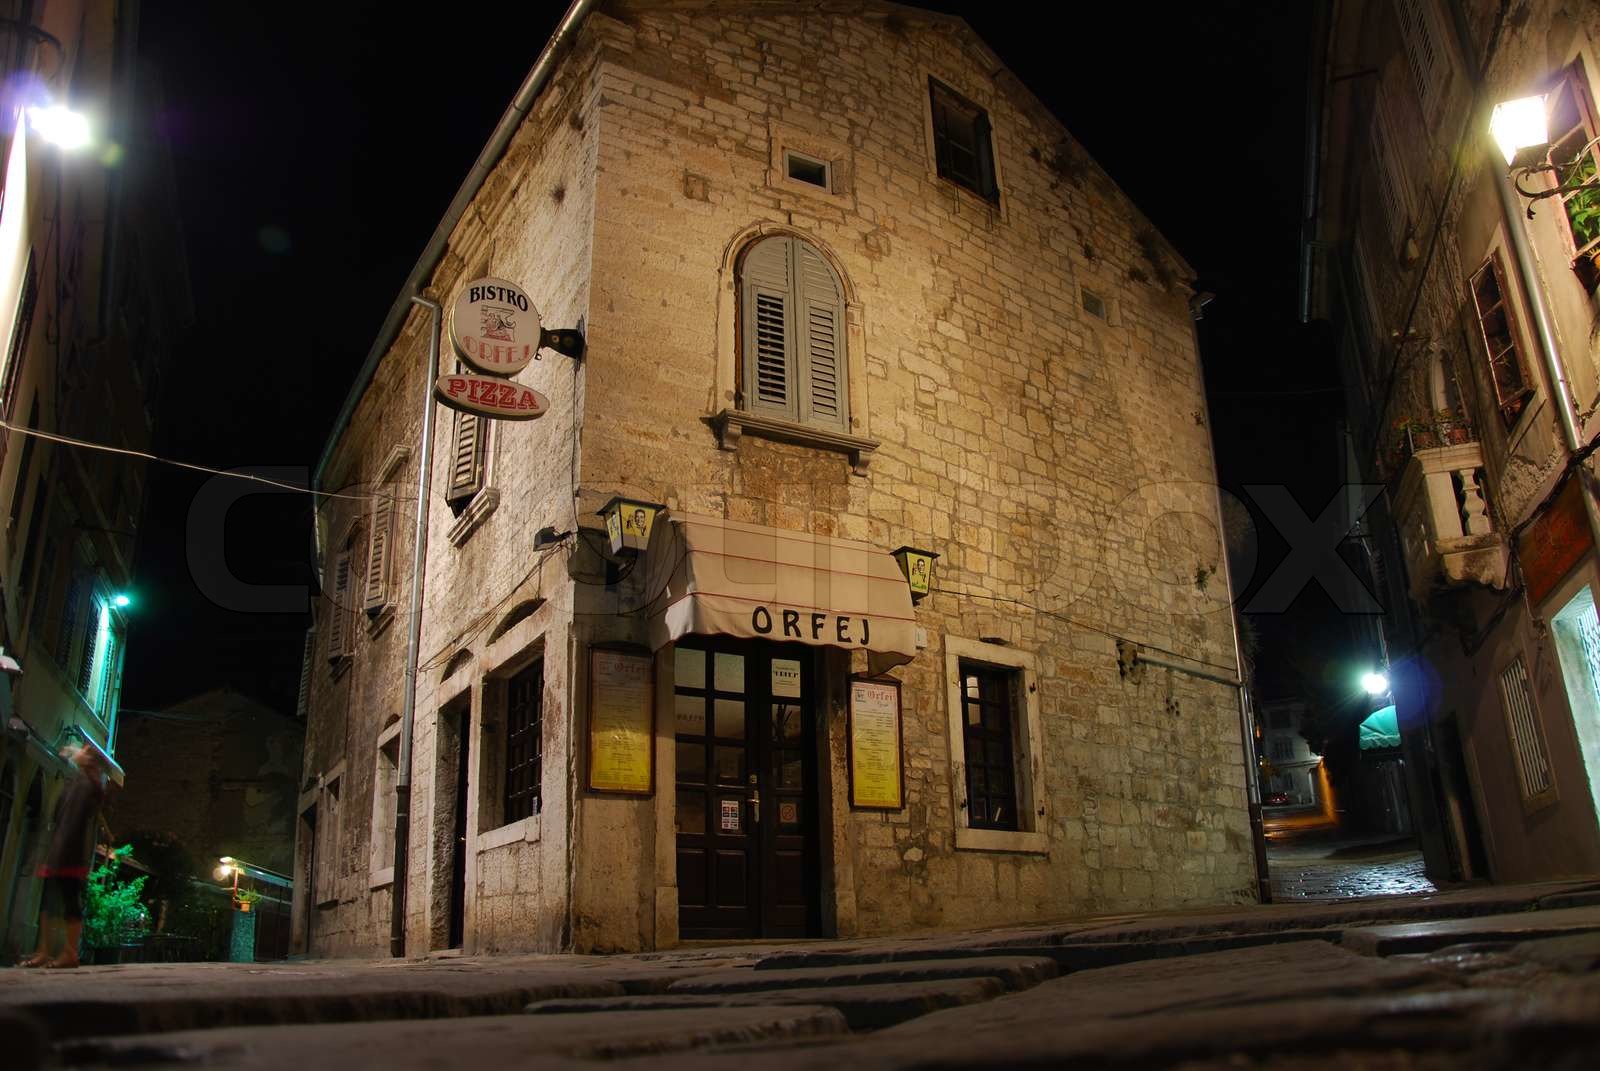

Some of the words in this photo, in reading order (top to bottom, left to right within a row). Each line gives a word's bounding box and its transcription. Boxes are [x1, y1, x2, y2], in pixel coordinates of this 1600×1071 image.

[470, 286, 528, 311] BISTRO
[447, 379, 539, 409] PIZZA
[752, 606, 869, 645] ORFEJ
